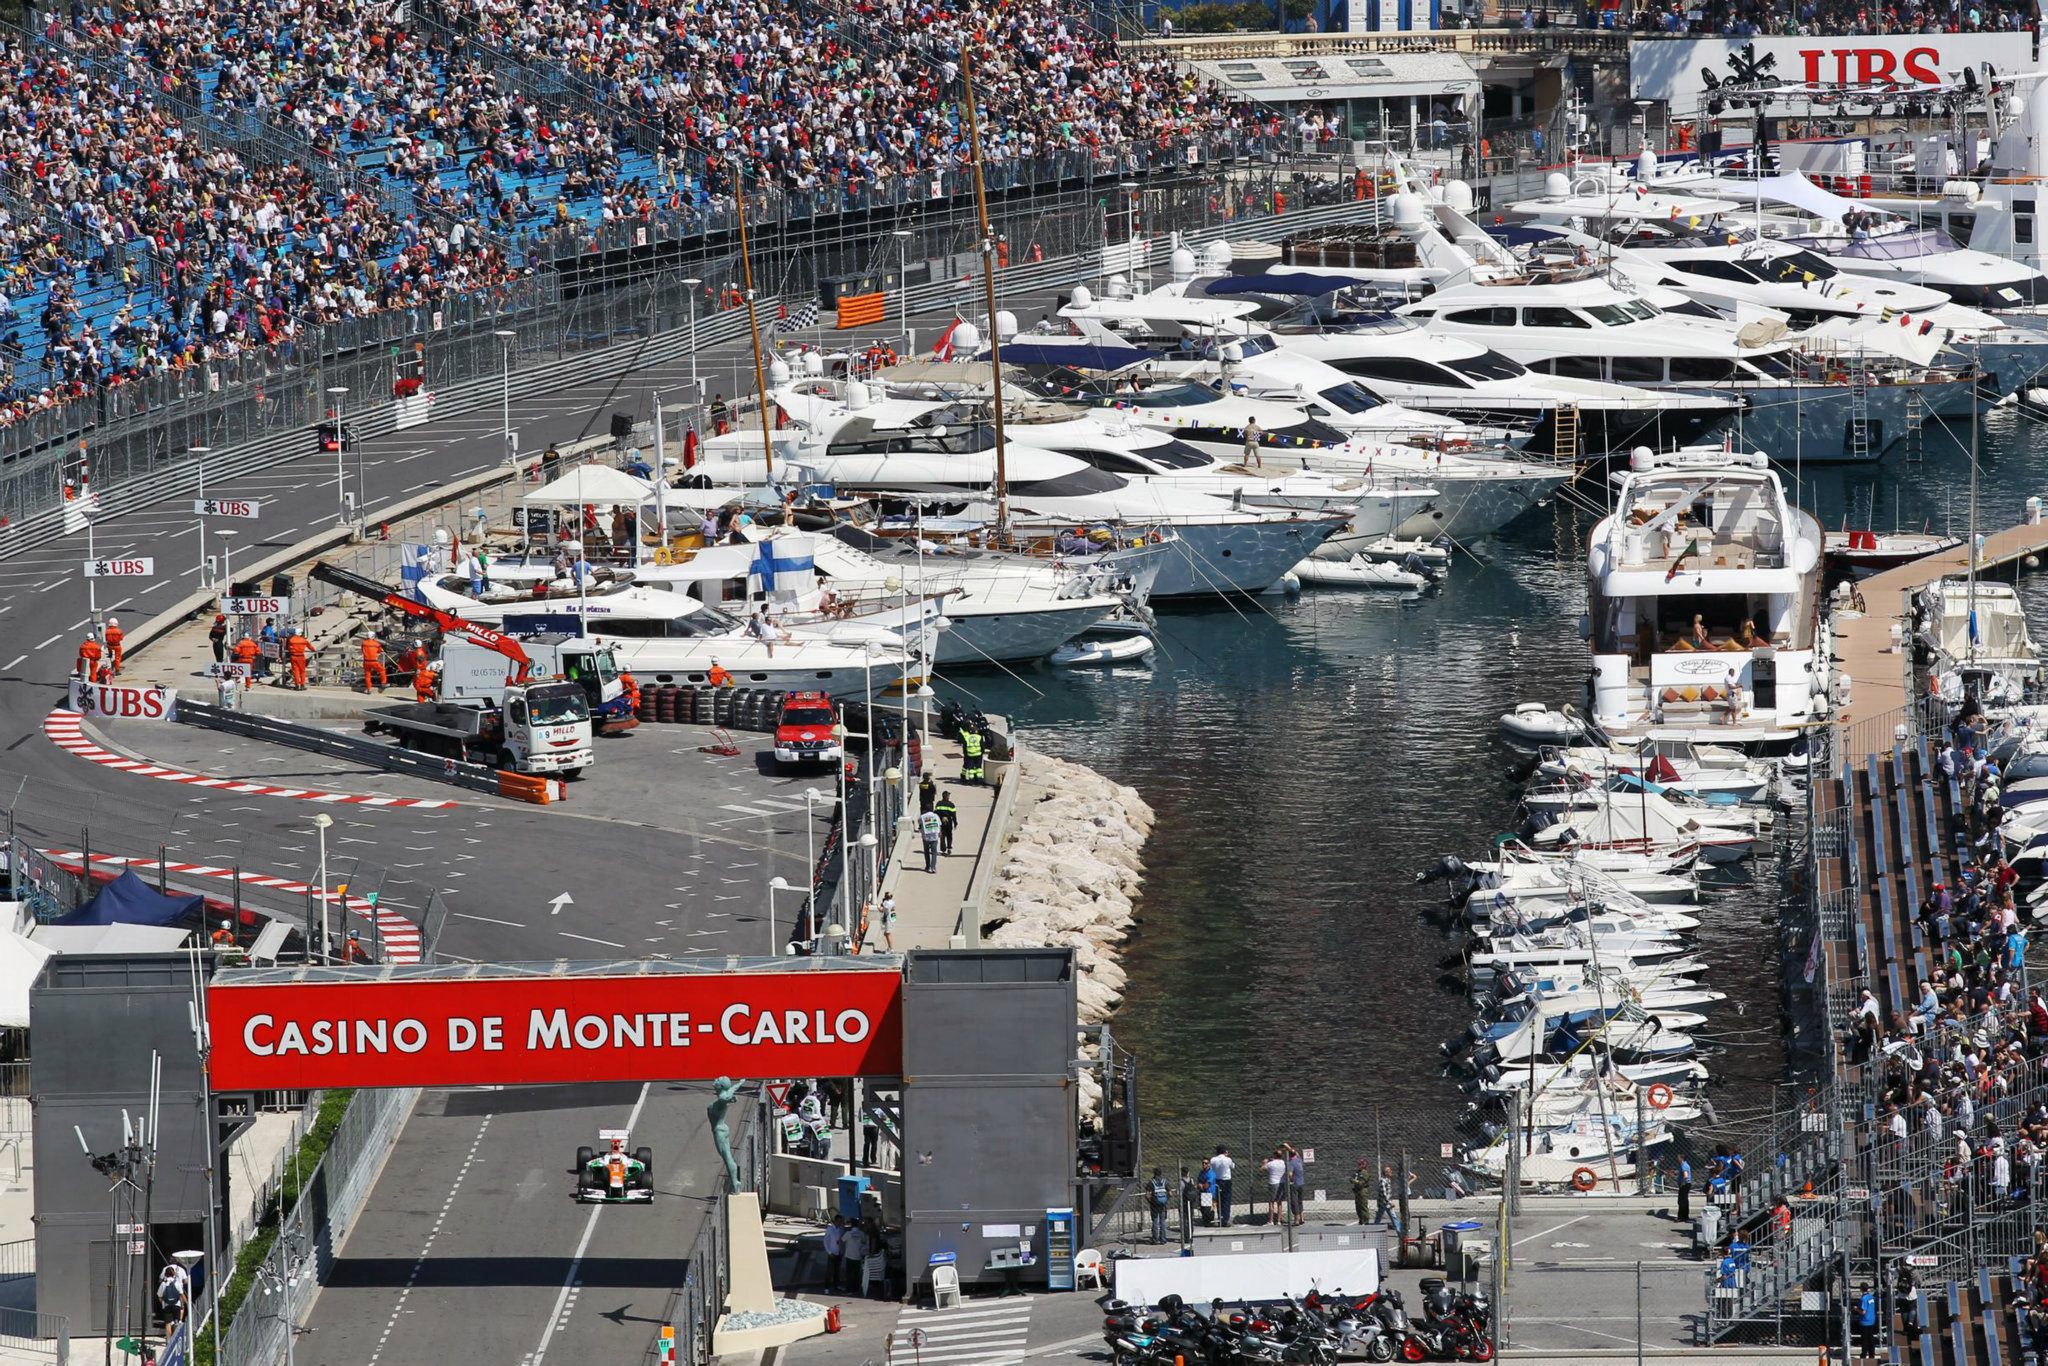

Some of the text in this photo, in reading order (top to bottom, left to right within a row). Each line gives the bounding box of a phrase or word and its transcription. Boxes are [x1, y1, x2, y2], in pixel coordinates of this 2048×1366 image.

[1798, 47, 1941, 88] UBS
[220, 501, 249, 517] UBS
[111, 560, 144, 575] UBS
[246, 598, 279, 613] UBS
[465, 622, 499, 643] MILLO
[221, 664, 244, 676] UBS
[99, 688, 163, 718] UBS
[552, 725, 576, 736] MILLO
[242, 1003, 871, 1057] CASINO DE MONTE-CARLO
